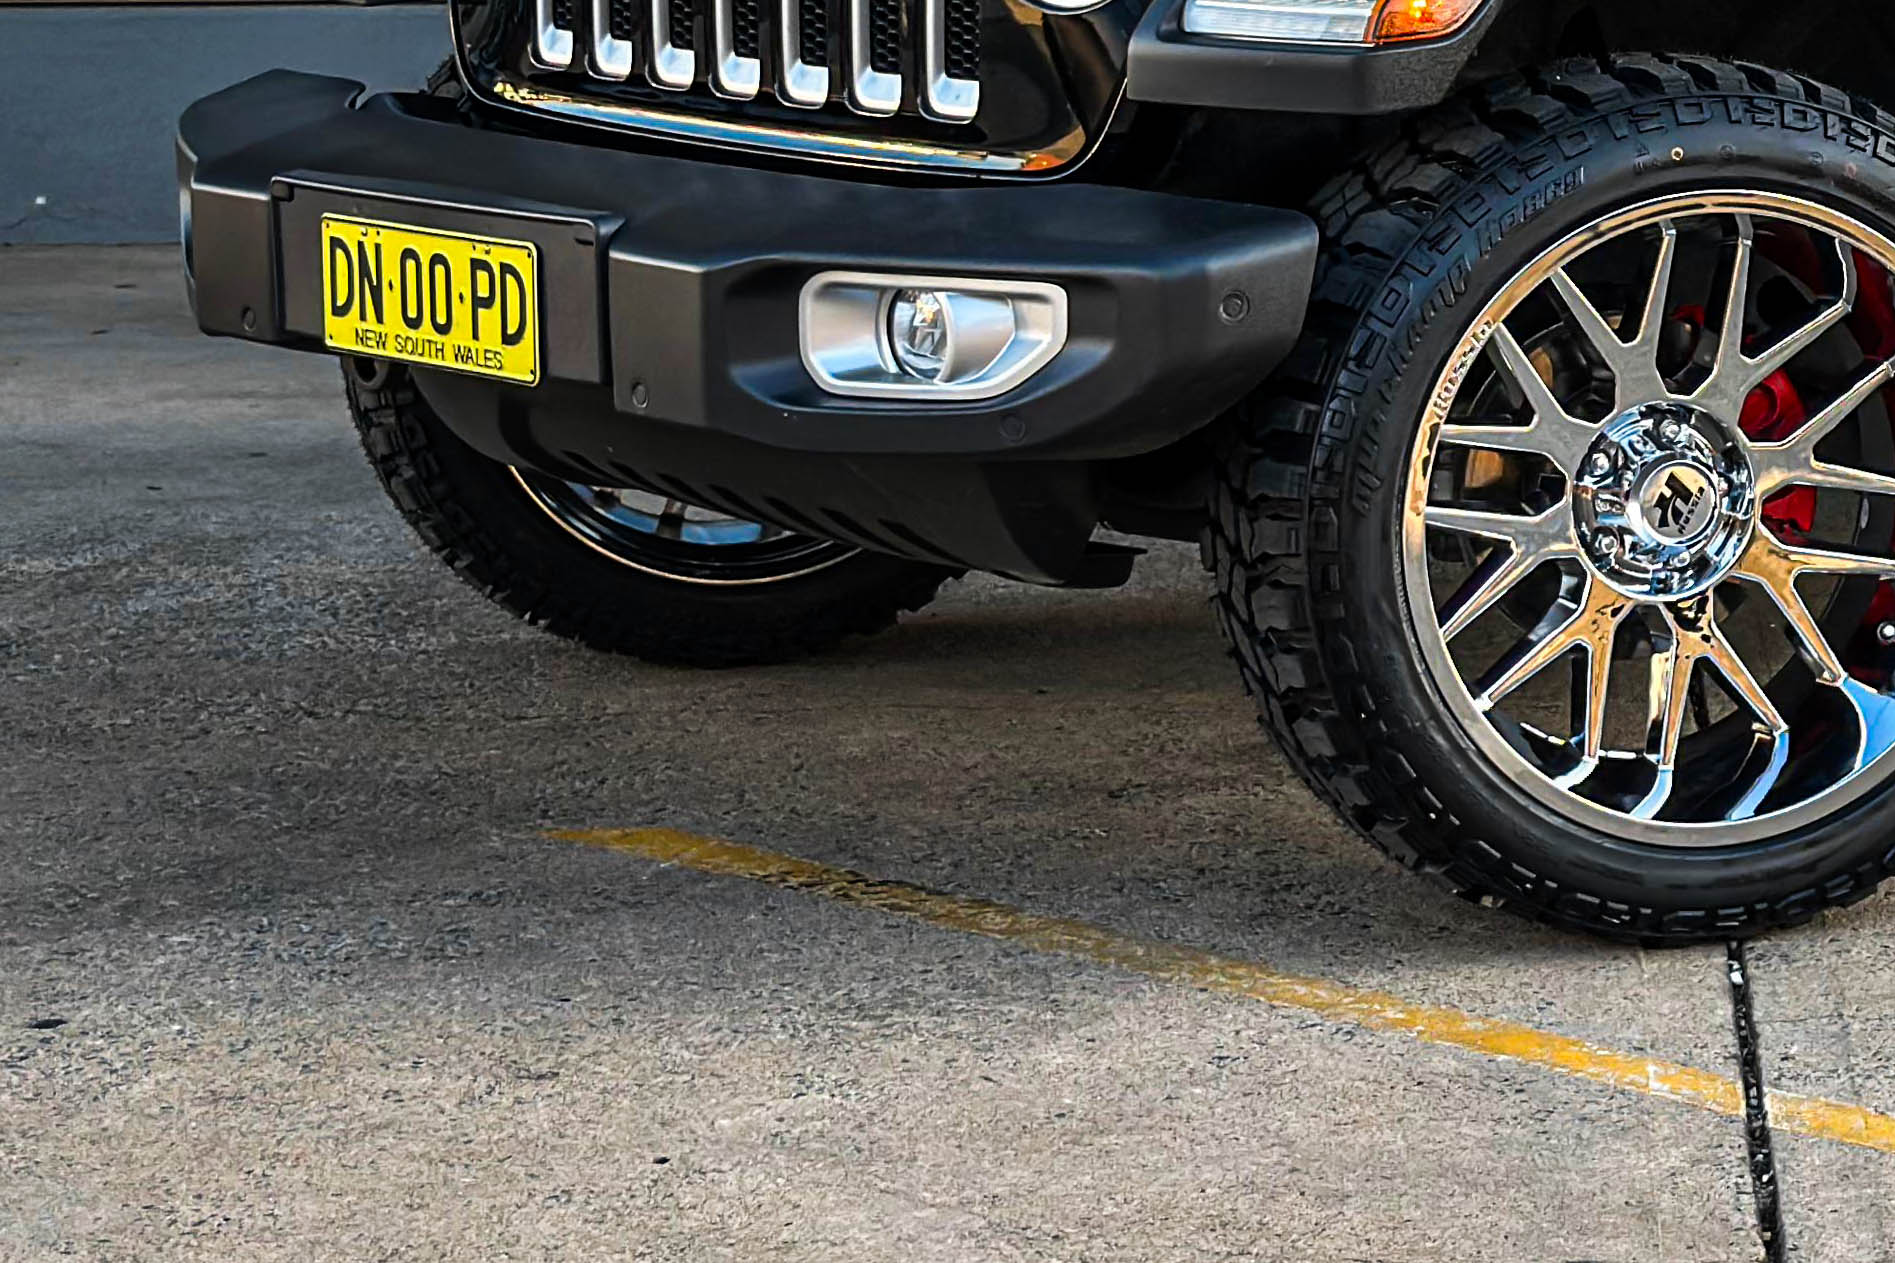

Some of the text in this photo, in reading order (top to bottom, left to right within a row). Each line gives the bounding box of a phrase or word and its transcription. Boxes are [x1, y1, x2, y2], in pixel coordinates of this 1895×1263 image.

[354, 327, 504, 370] NEW SOUTH WALES
